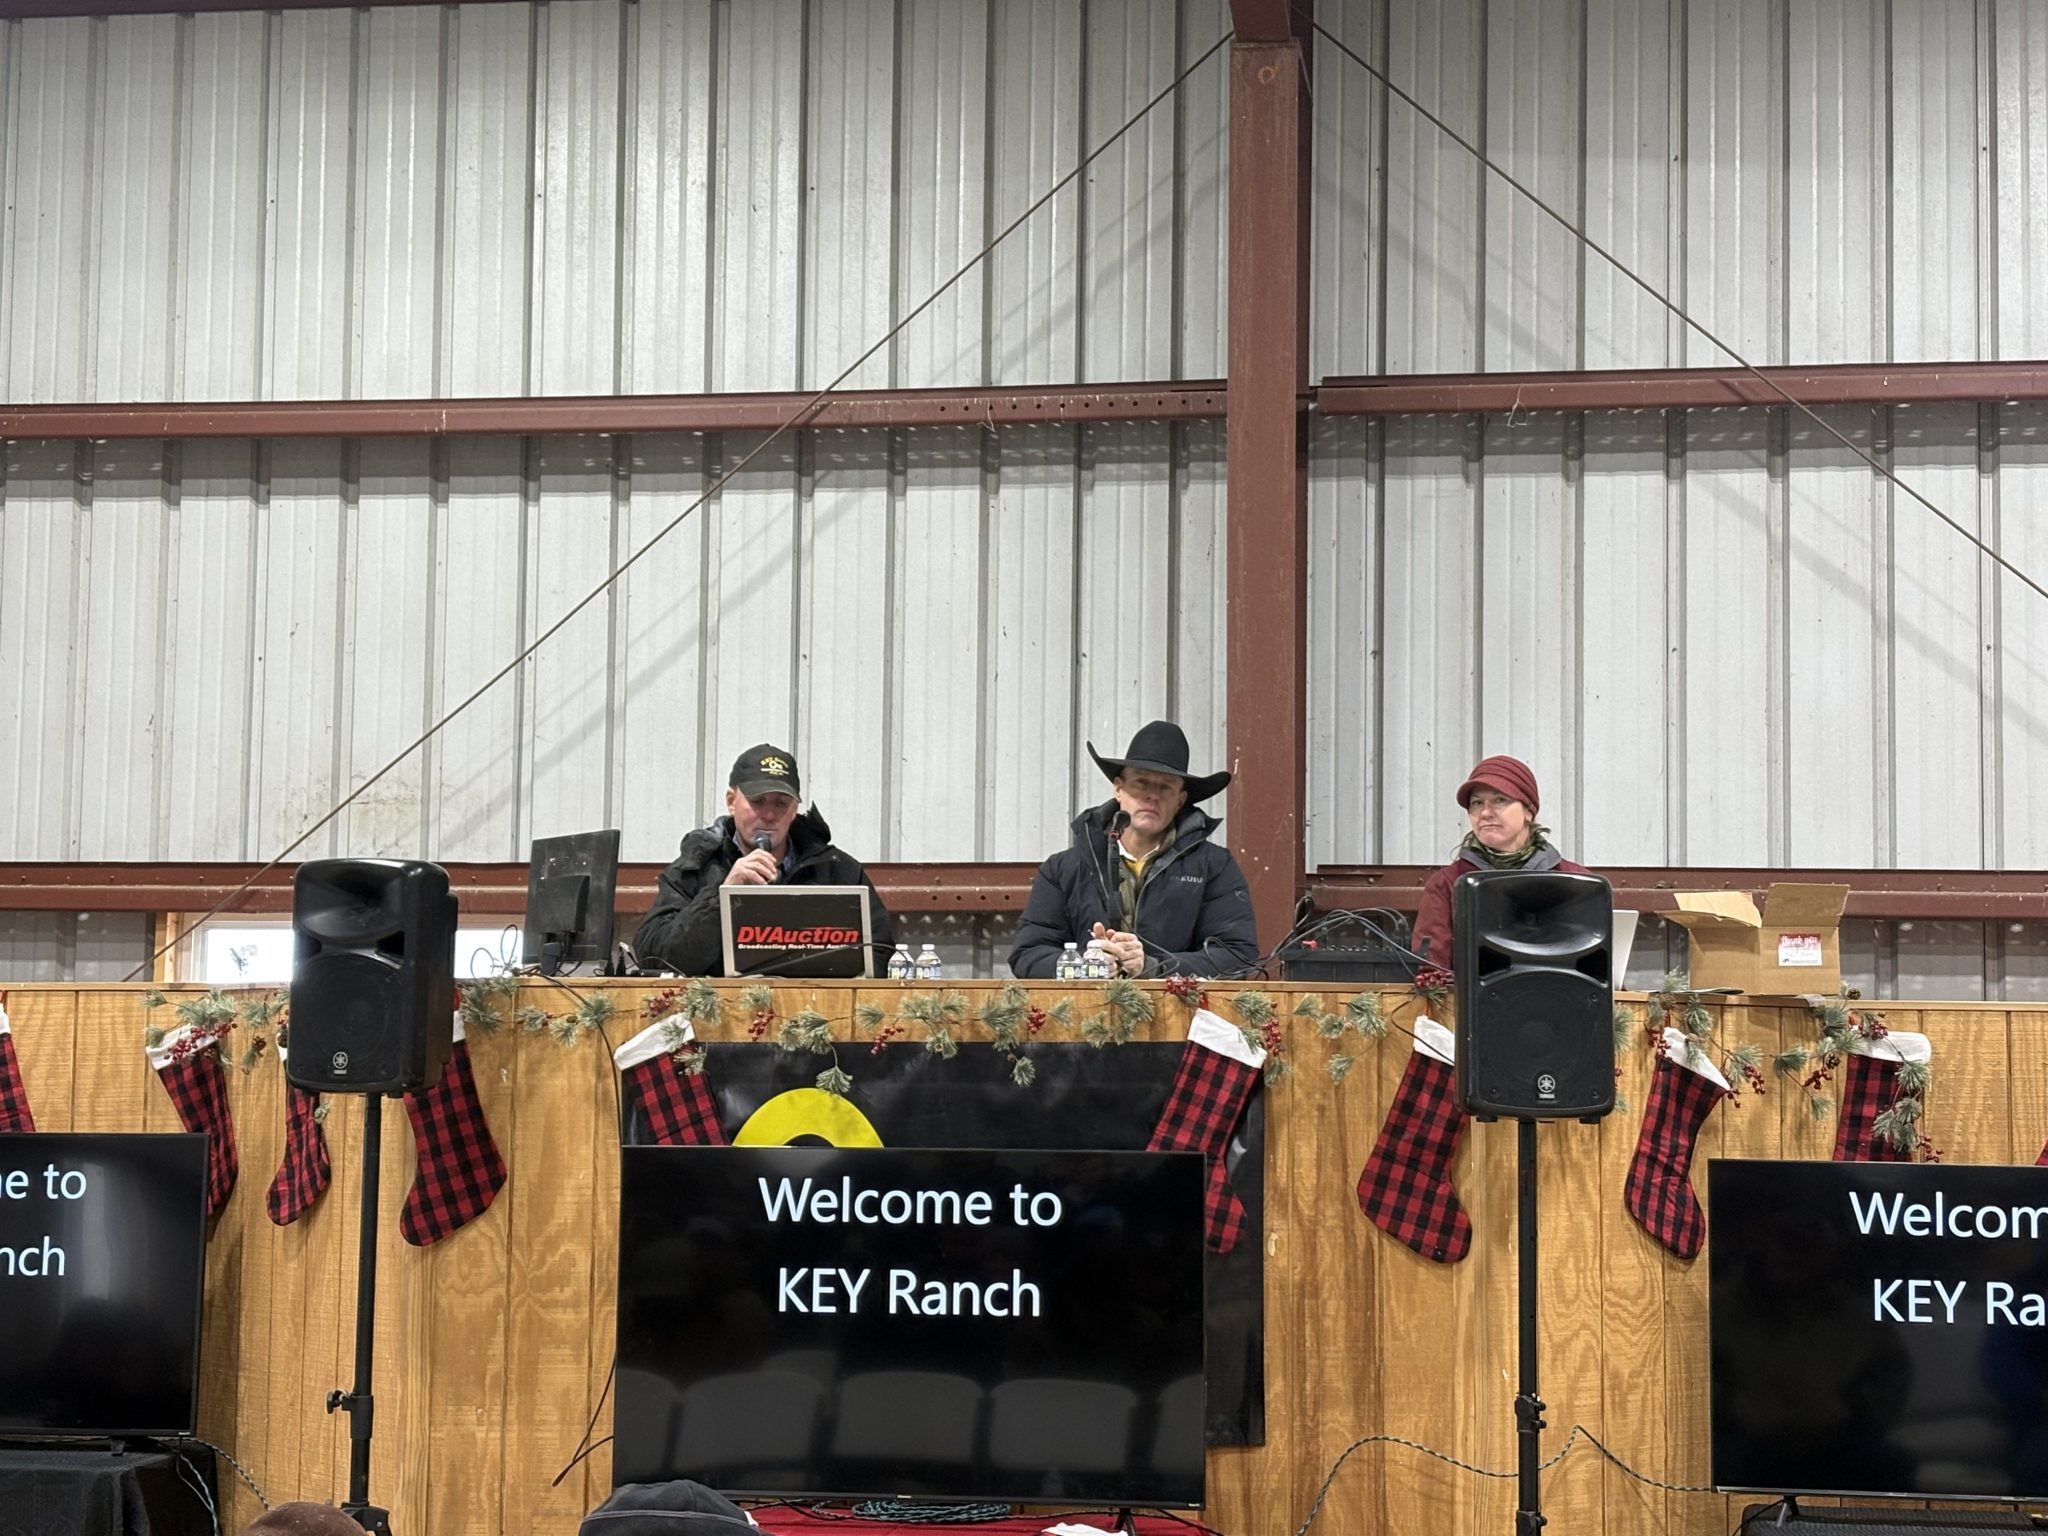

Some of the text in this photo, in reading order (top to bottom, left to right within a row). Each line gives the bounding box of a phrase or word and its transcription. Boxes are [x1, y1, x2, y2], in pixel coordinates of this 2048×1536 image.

[737, 926, 859, 943] DVAuction
[43, 1163, 87, 1200] to
[758, 1176, 1062, 1227] Welcome to
[778, 1267, 1040, 1317] KEY Ranch
[1874, 1278, 2046, 1327] KEY Ra
